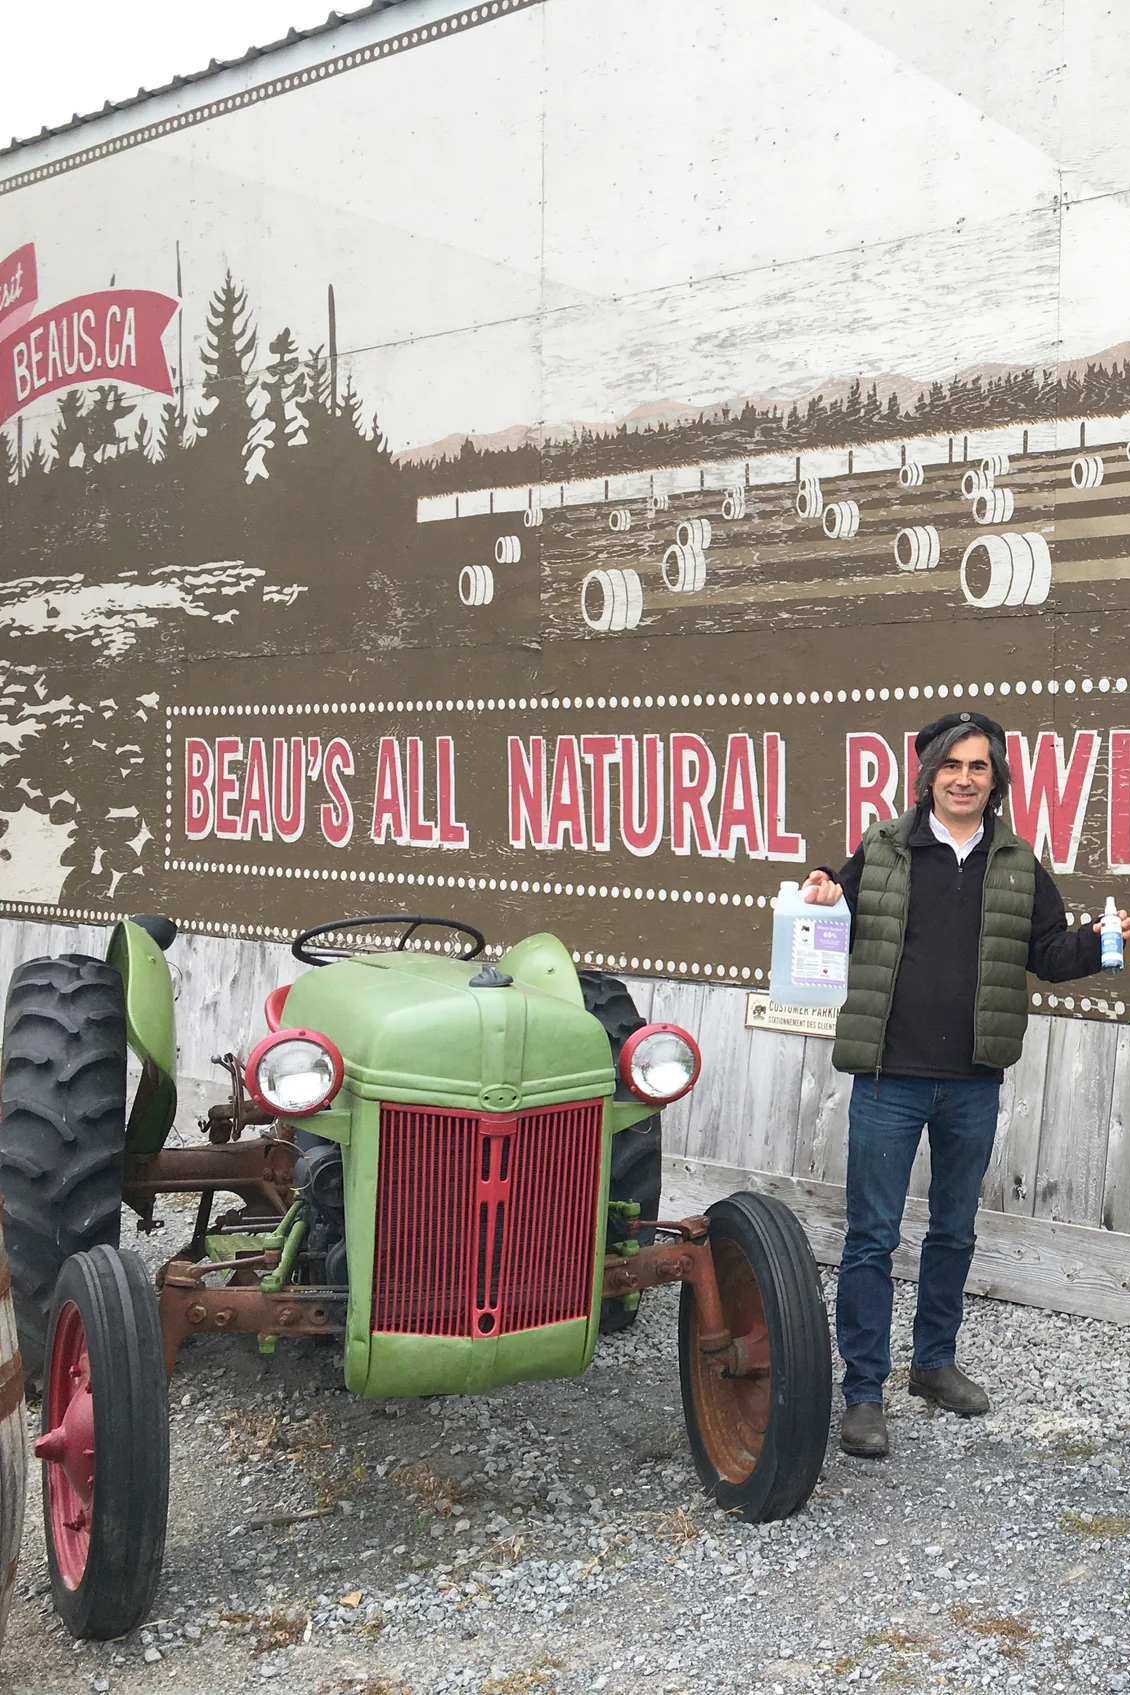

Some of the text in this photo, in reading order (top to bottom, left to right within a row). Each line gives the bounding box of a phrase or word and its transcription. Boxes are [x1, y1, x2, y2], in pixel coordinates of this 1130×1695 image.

[0, 262, 23, 311] sit
[13, 305, 136, 402] BEAUS.CA
[184, 736, 354, 848] BEAU'S
[370, 736, 469, 849] ALL
[507, 732, 806, 863] NATURAL
[768, 1015, 836, 1031] STATIONNEMENT DES CLIENT
